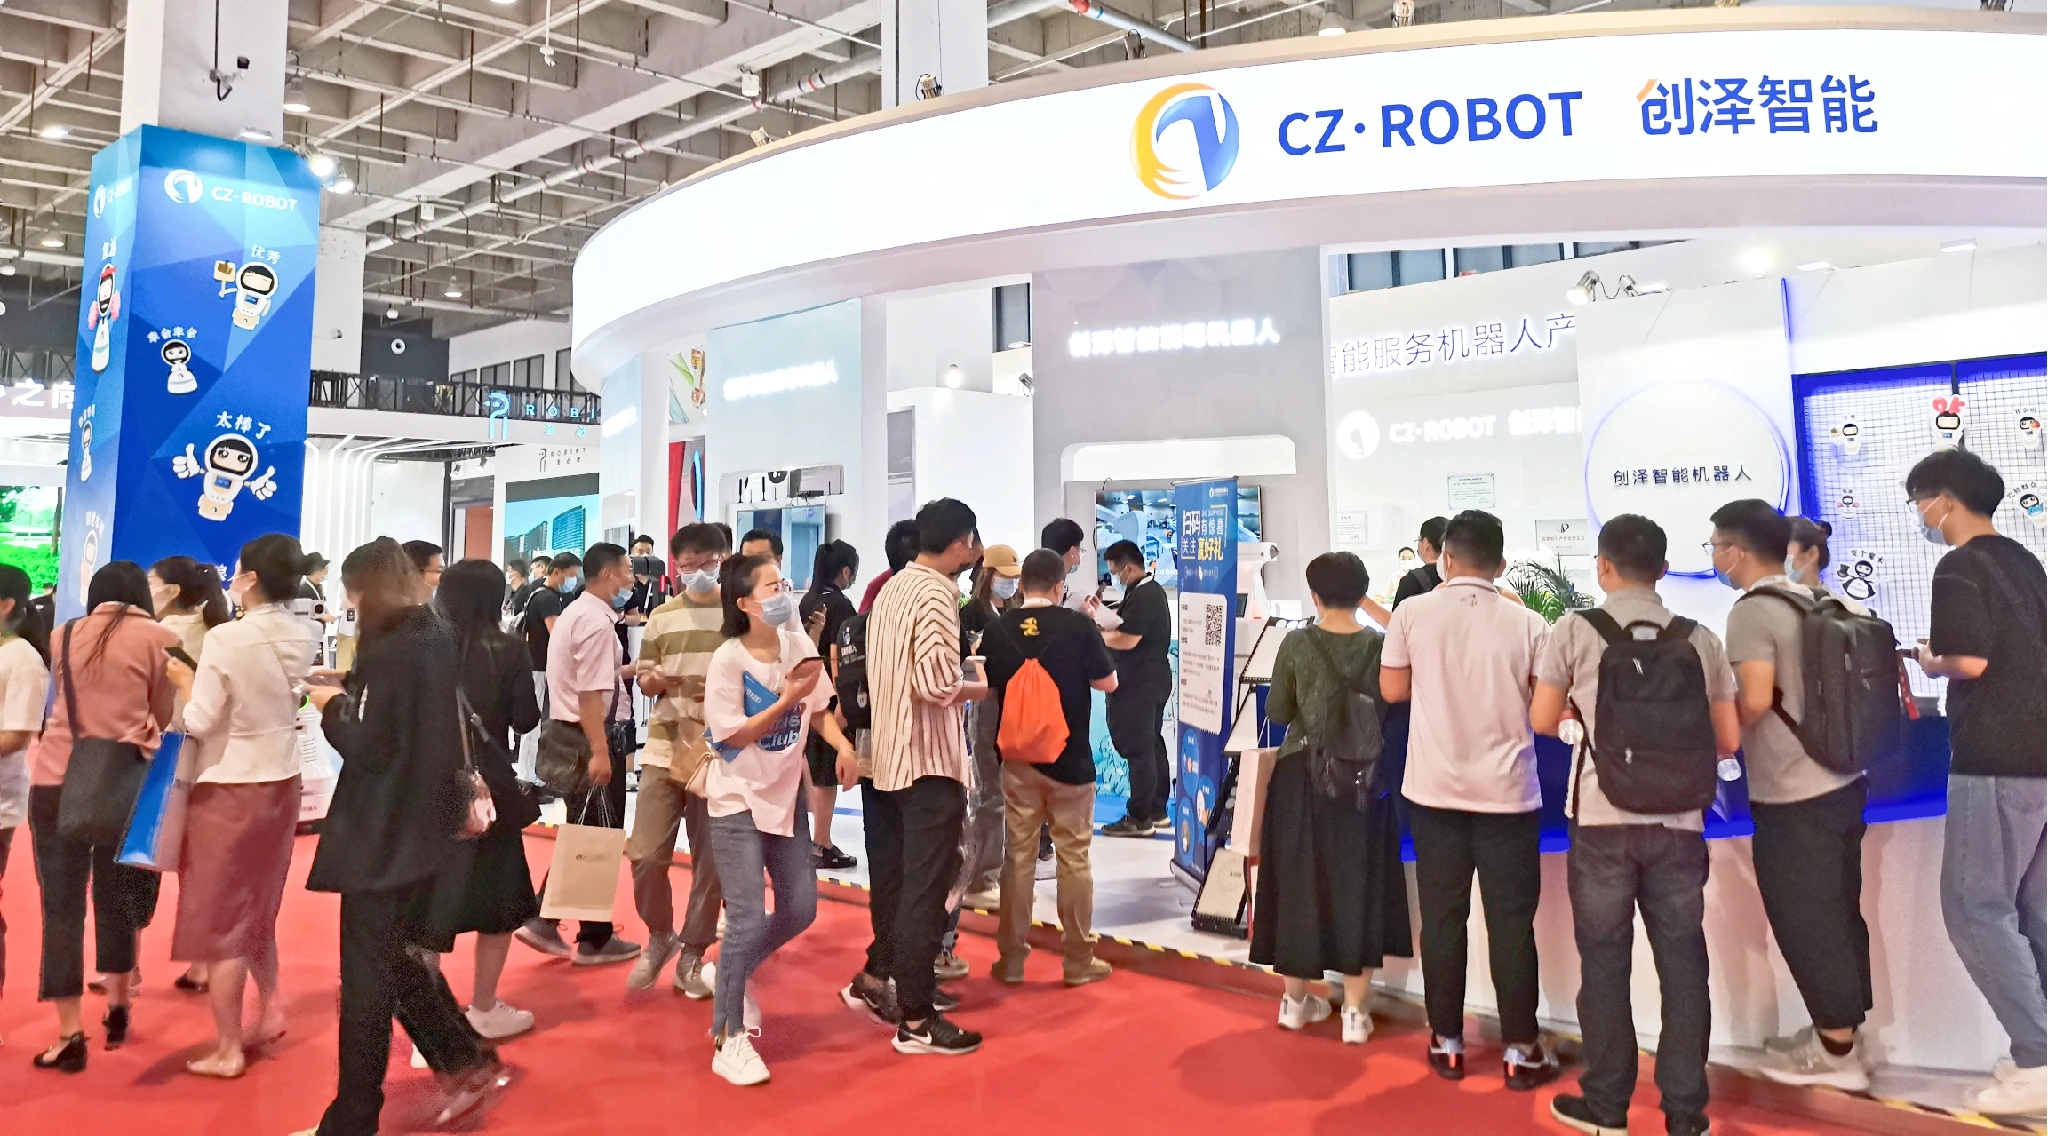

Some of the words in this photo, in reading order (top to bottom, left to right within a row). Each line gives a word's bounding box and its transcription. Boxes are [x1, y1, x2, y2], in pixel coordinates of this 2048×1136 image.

[1636, 74, 1879, 136] 创泽智能
[1278, 90, 1584, 156] CZ·ROBOT
[251, 244, 281, 265] 优秀
[215, 410, 272, 440] 太棒了
[1389, 415, 1497, 444] CZ·ROBOT
[1507, 406, 1582, 436] 创泽智
[1613, 464, 1752, 487] 创泽智能机器人
[759, 730, 800, 749] Club
